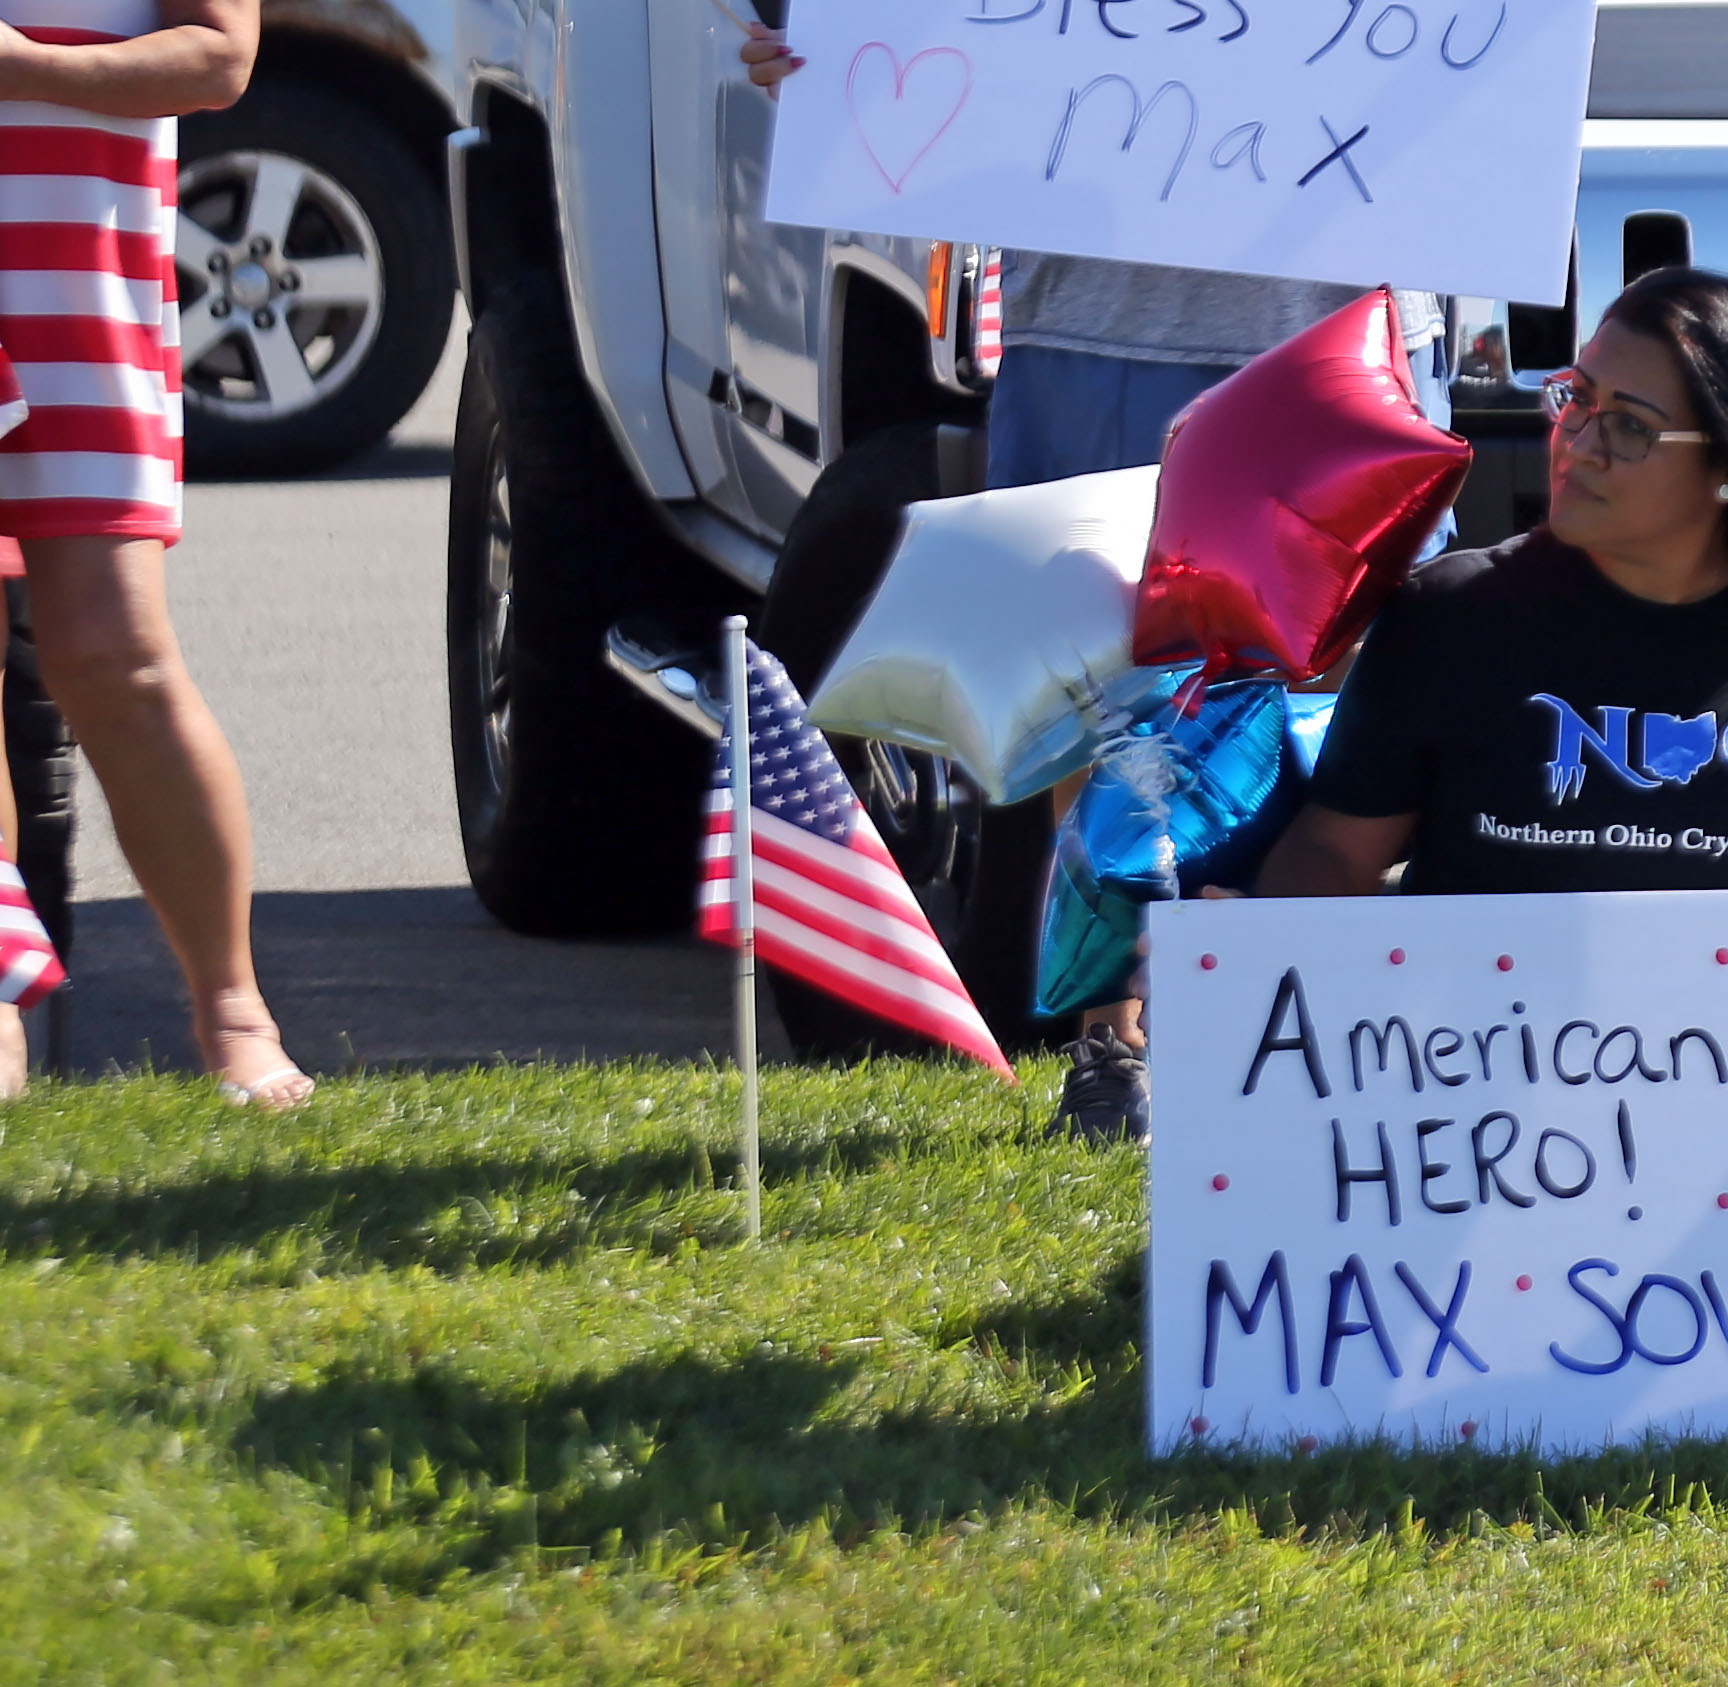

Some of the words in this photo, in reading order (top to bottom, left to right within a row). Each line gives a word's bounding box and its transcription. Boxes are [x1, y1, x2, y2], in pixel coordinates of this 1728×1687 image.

[1478, 813, 1597, 848] Northern
[1605, 823, 1673, 851] Ohio
[1330, 1097, 1645, 1226] HERO!
[1200, 1248, 1490, 1394] MAX
